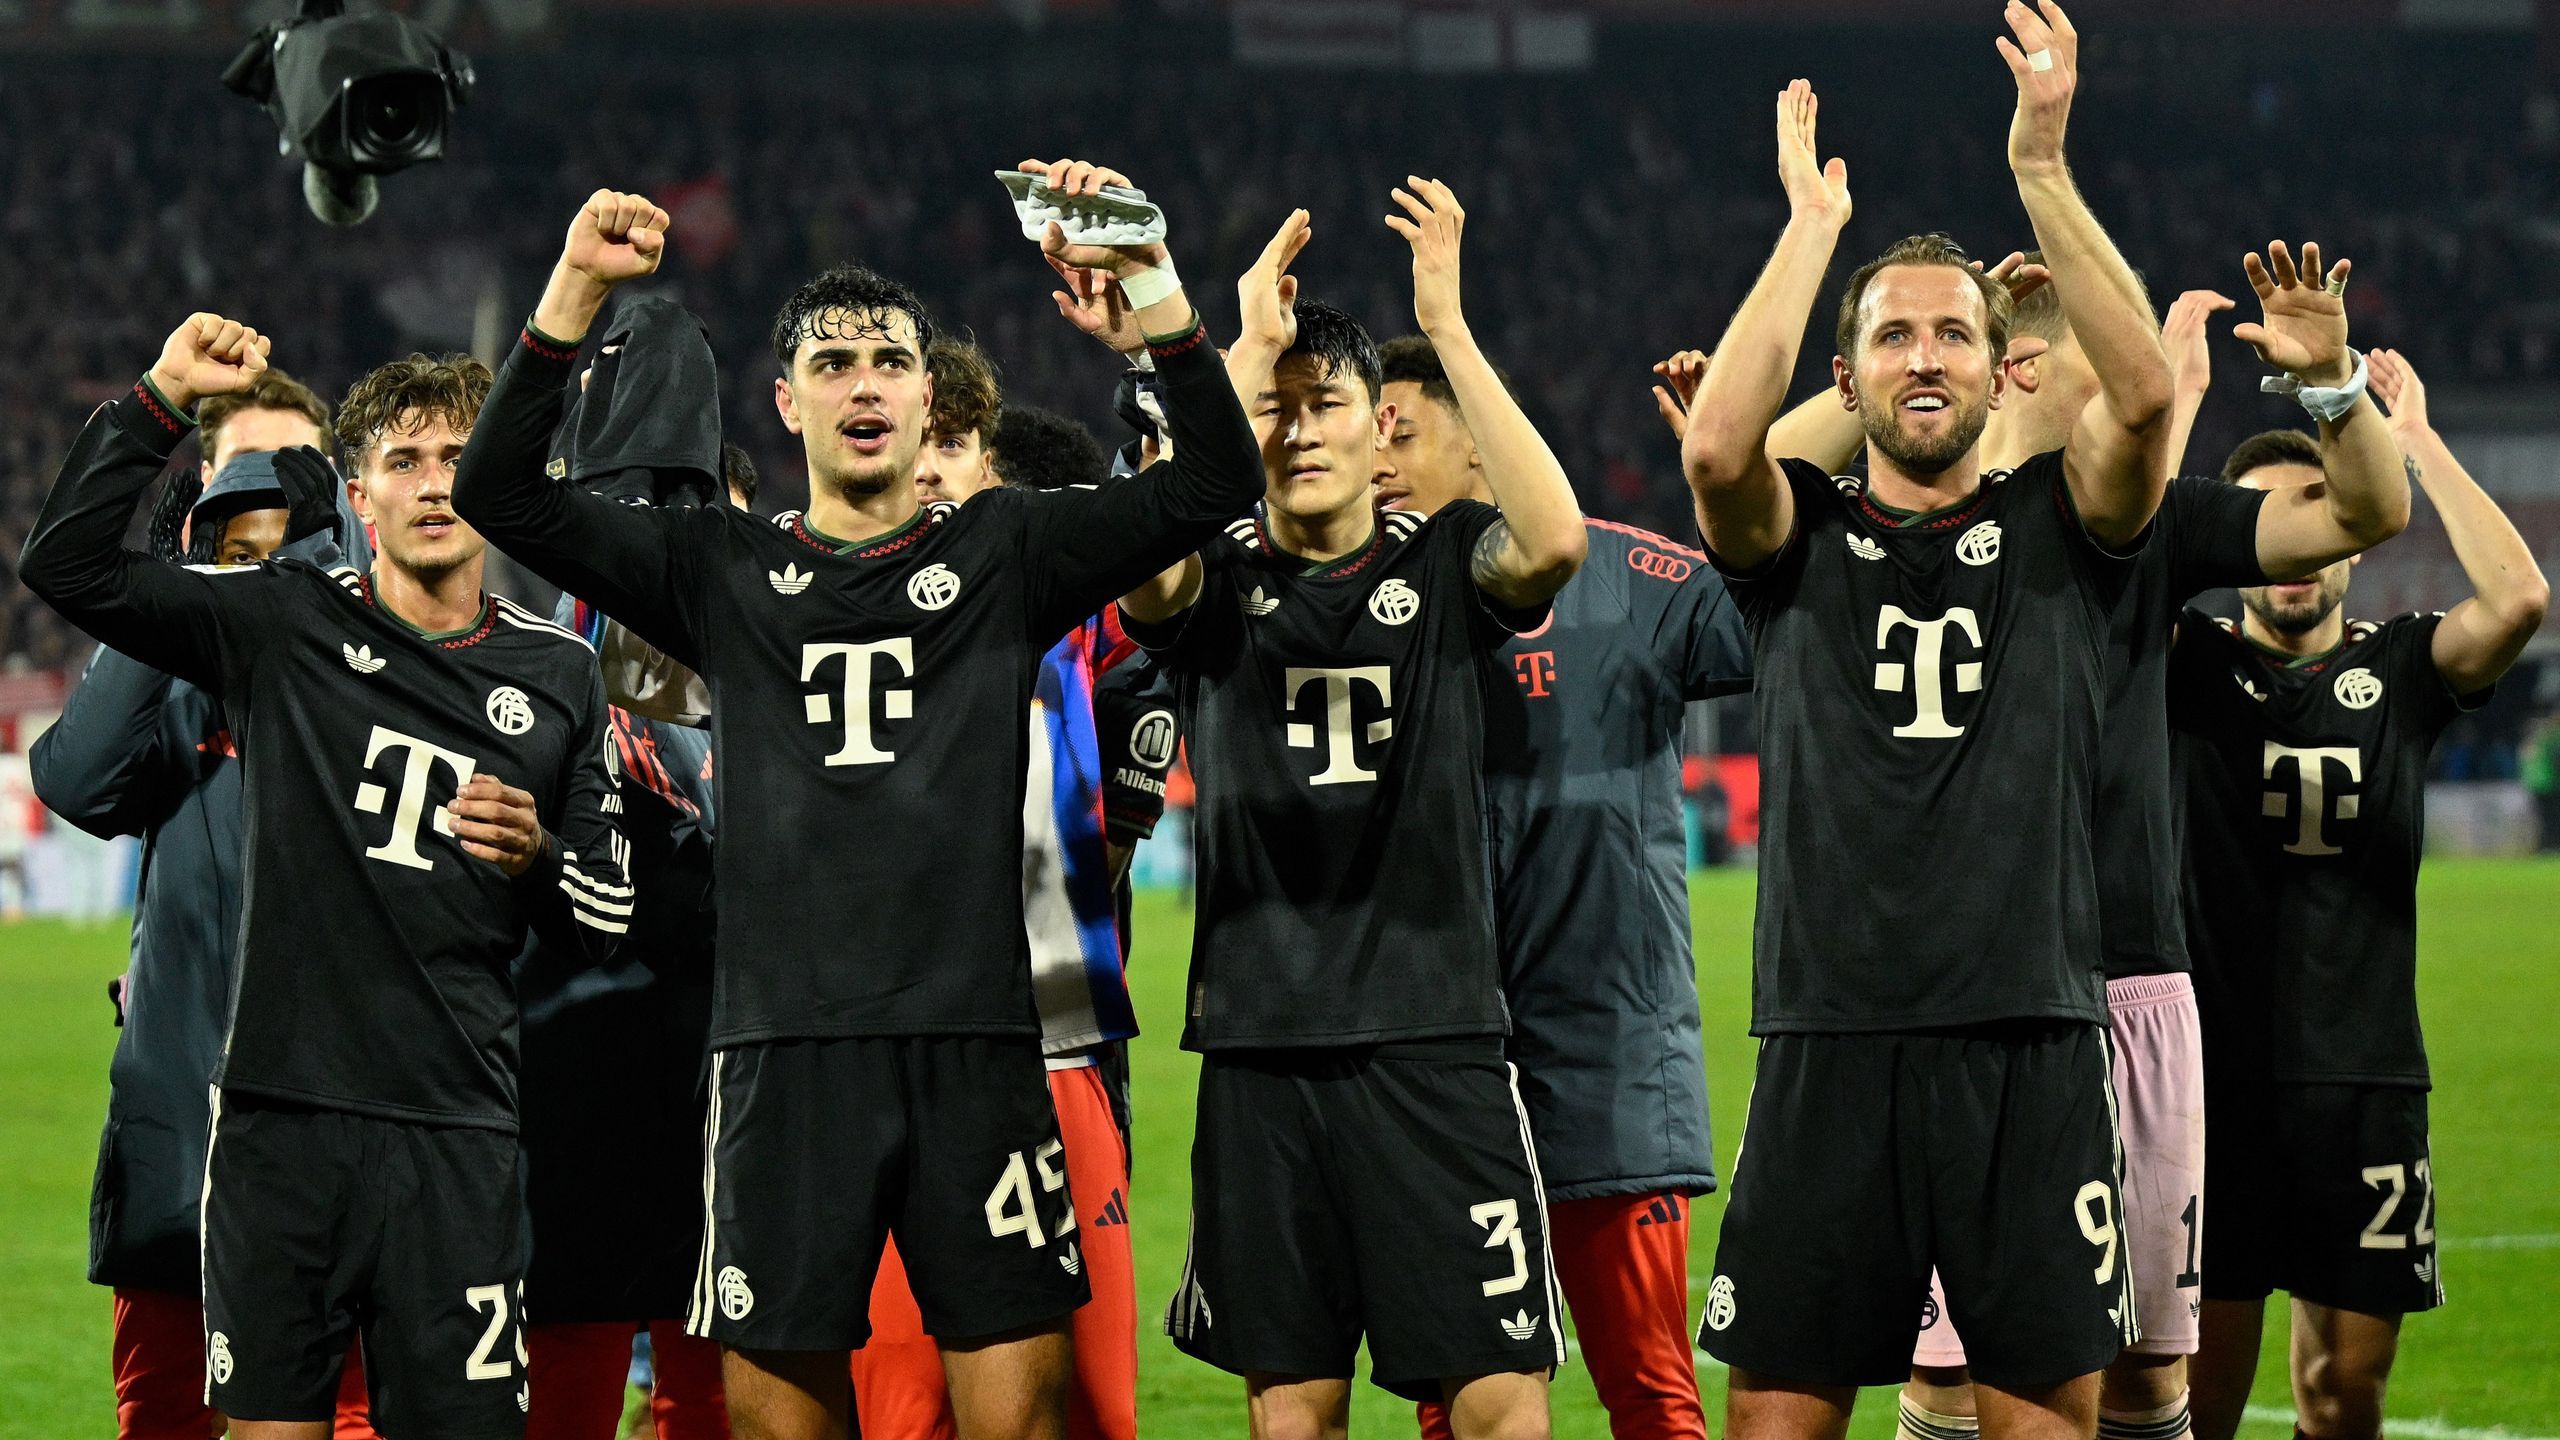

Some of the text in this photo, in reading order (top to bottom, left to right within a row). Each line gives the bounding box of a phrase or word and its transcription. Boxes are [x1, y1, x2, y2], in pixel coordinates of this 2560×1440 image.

[801, 637, 914, 766] T
[1515, 651, 1557, 697] T
[1875, 605, 1983, 738] T
[1286, 666, 1392, 785] T
[1113, 767, 1166, 798] Allian
[985, 1136, 1077, 1249] 45
[2074, 1180, 2118, 1285] 9
[2176, 1194, 2200, 1289] 1
[1470, 1199, 1530, 1298] 3
